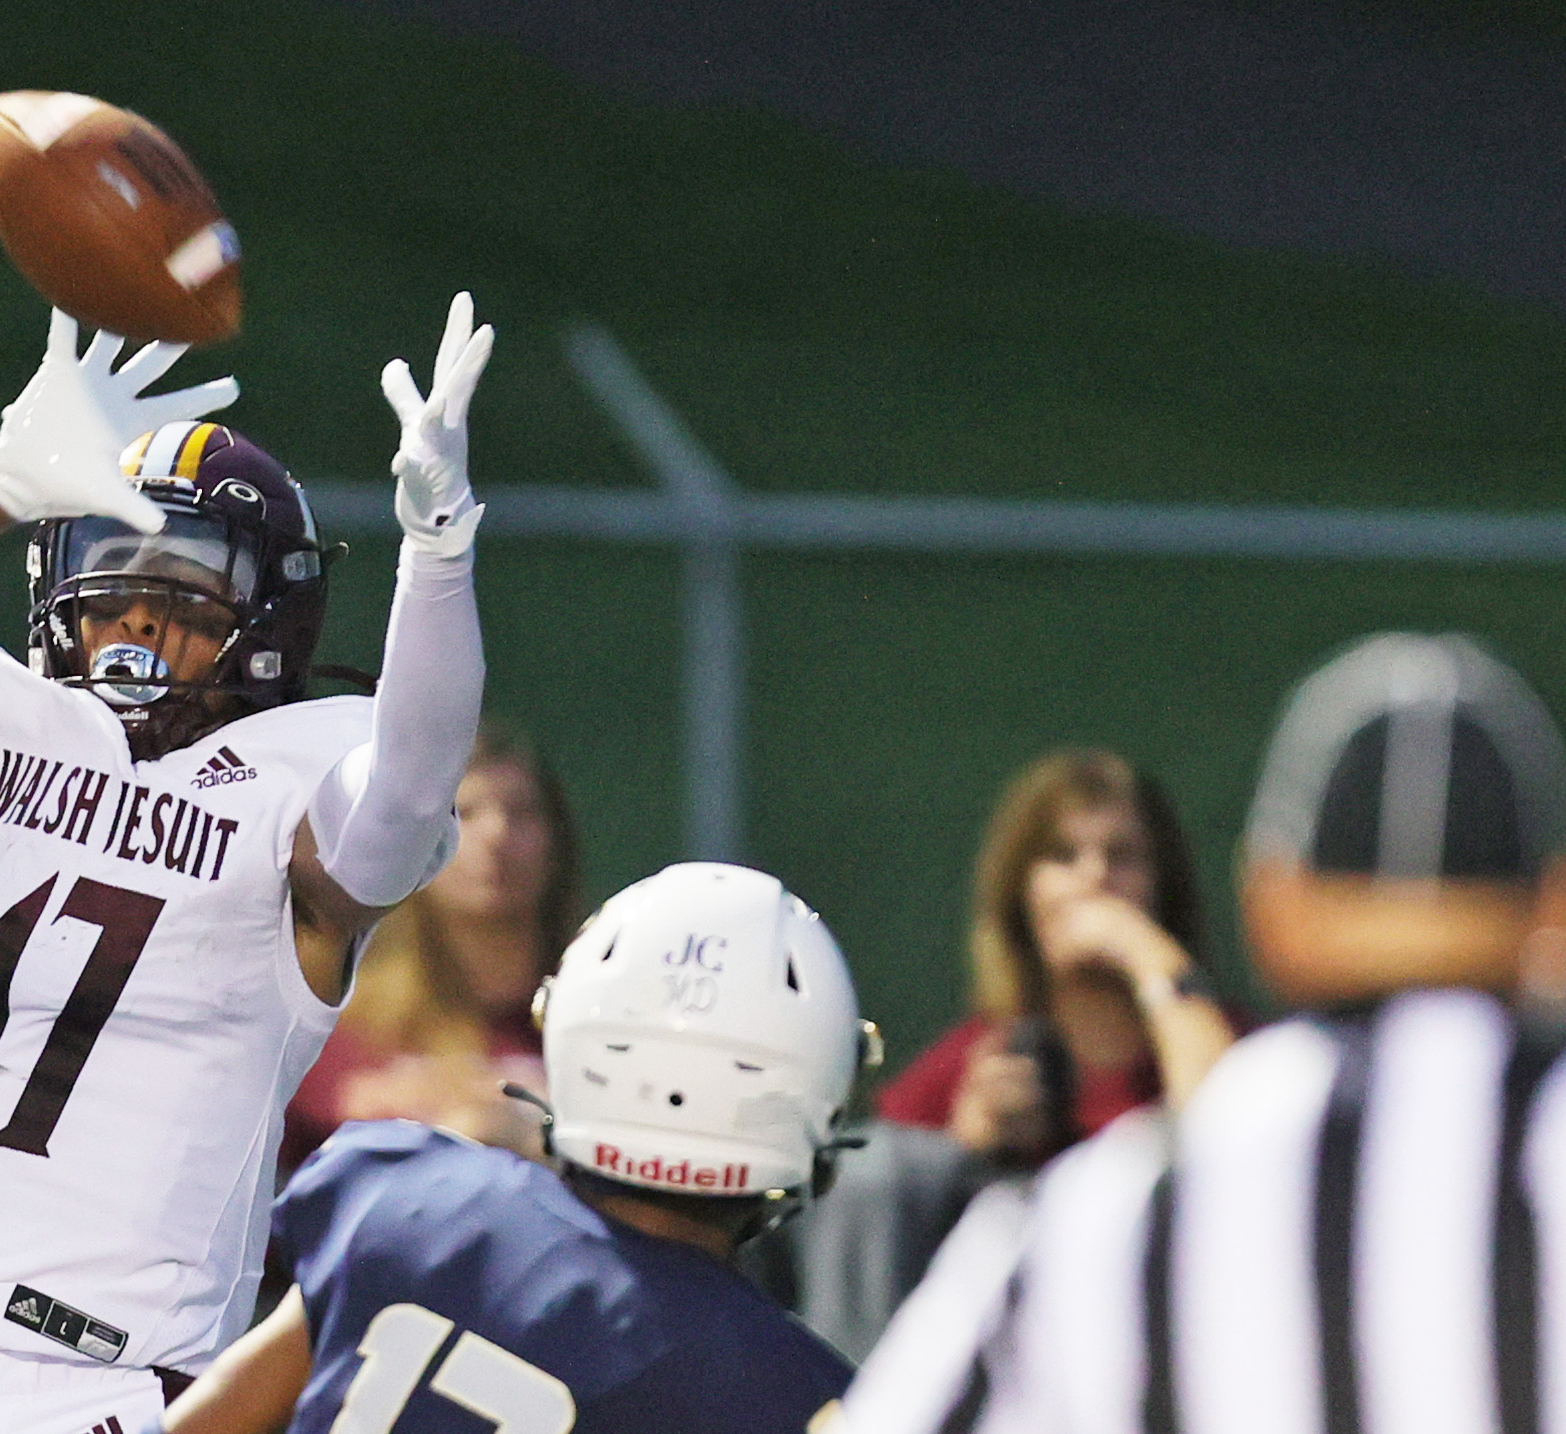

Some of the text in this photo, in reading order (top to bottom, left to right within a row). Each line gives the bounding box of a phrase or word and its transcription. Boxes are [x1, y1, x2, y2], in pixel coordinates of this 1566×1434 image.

[190, 767, 257, 789] adidas
[102, 780, 239, 882] JESUIT
[663, 932, 728, 973] JC
[594, 1141, 750, 1189] Riddell
